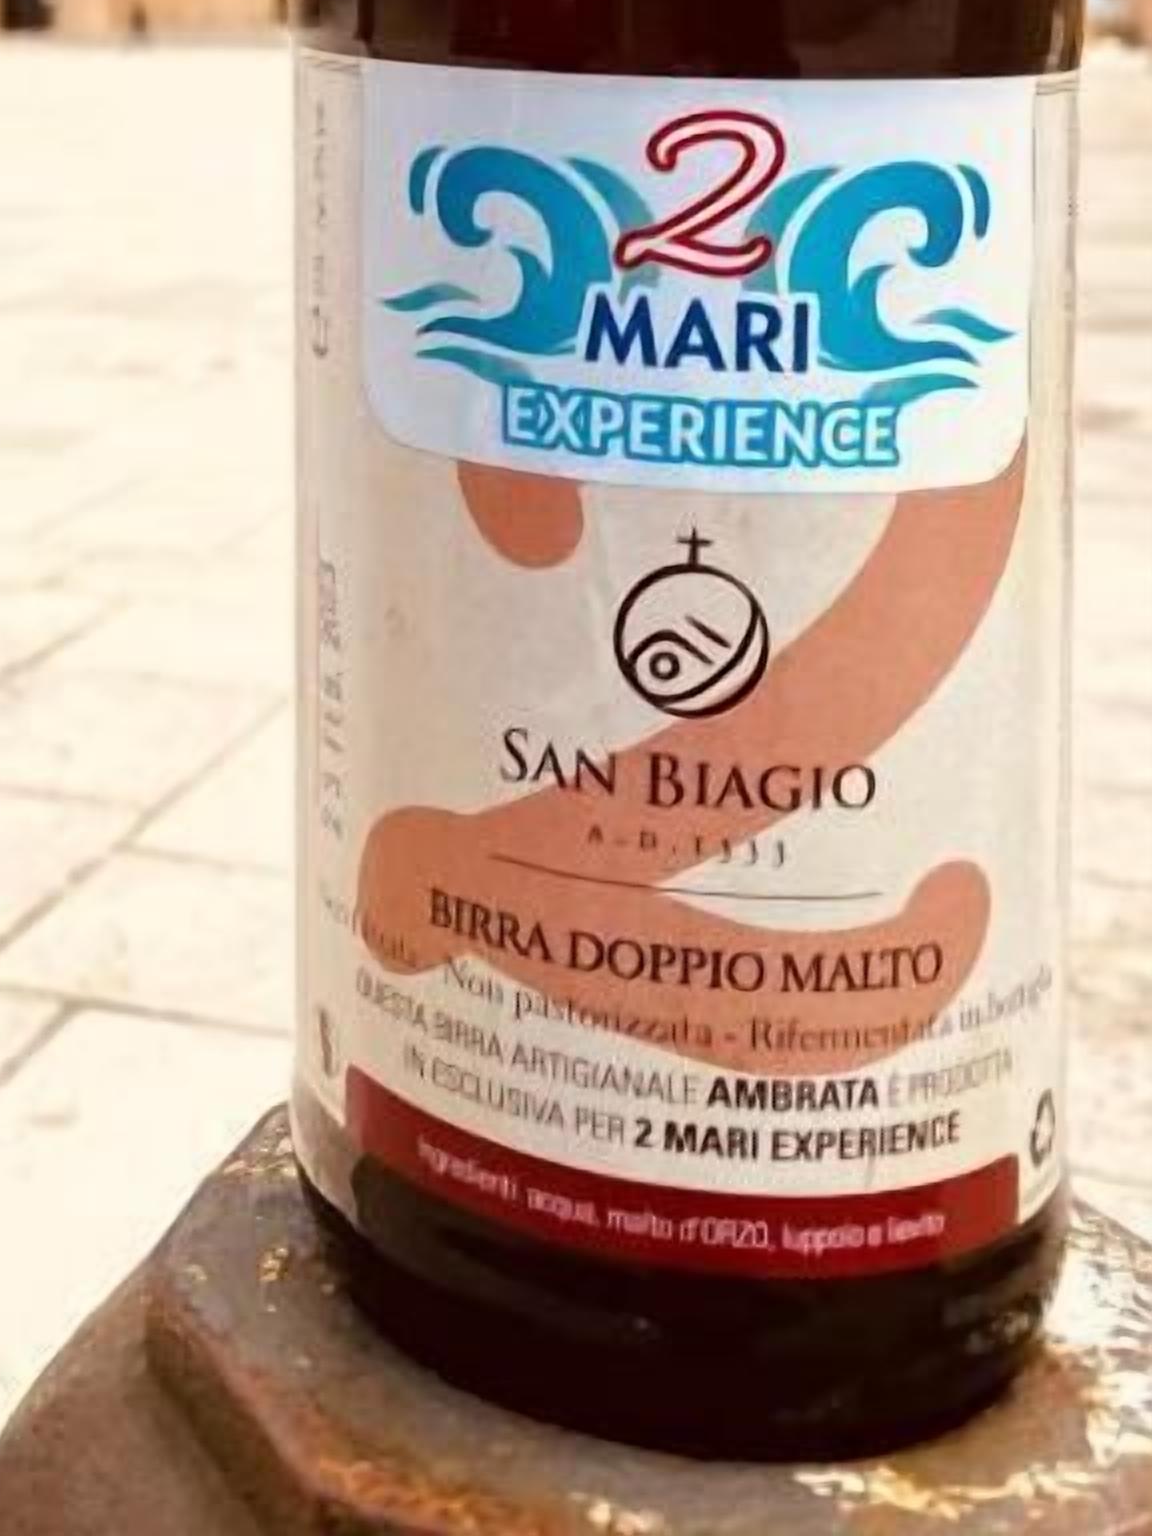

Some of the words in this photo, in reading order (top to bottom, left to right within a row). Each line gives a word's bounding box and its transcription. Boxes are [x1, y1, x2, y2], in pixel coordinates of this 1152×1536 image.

[614, 109, 786, 277] 2
[584, 293, 810, 373] MARI
[503, 384, 901, 467] EXPERIENCE
[428, 888, 553, 964] BIRRA
[567, 930, 766, 993] DOPPIO
[780, 943, 944, 993] MALTO
[445, 957, 505, 1006] Non
[512, 1042, 698, 1106] ARTIGIANALE
[706, 1076, 879, 1112] AMBRATA
[576, 1106, 626, 1147] PER
[635, 1116, 653, 1149] 2
[663, 1119, 759, 1161] MARI
[771, 1109, 961, 1161] EXPERIENCE
